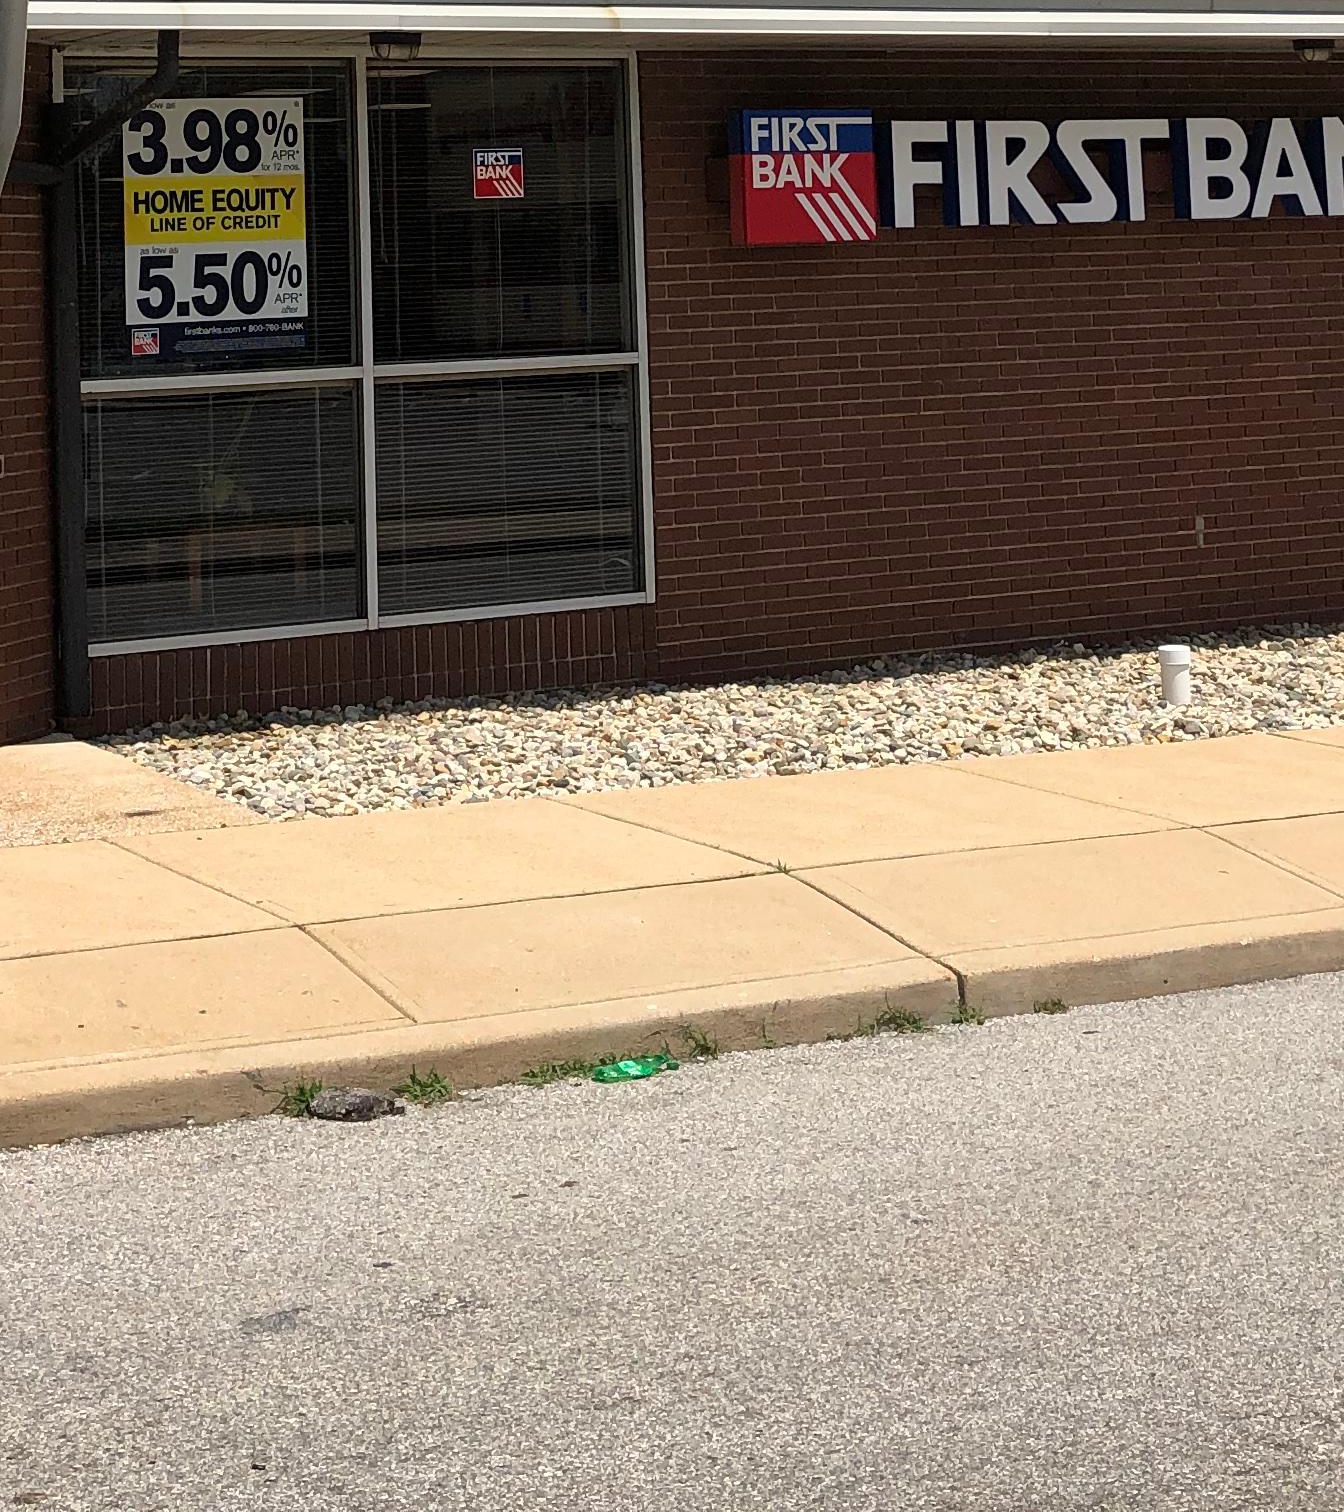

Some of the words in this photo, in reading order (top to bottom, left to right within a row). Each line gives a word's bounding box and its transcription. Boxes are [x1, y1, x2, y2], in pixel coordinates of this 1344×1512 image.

[127, 109, 299, 175] 3.98%
[750, 117, 872, 152] FIRST
[476, 152, 522, 165] FIRST
[891, 119, 1170, 228] FIRST
[133, 190, 204, 214] HOME
[212, 188, 296, 213] EQUITY
[150, 217, 187, 232] LINE
[193, 217, 215, 231] OF
[221, 215, 281, 230] CREDIT
[136, 250, 302, 319] 5.50%
